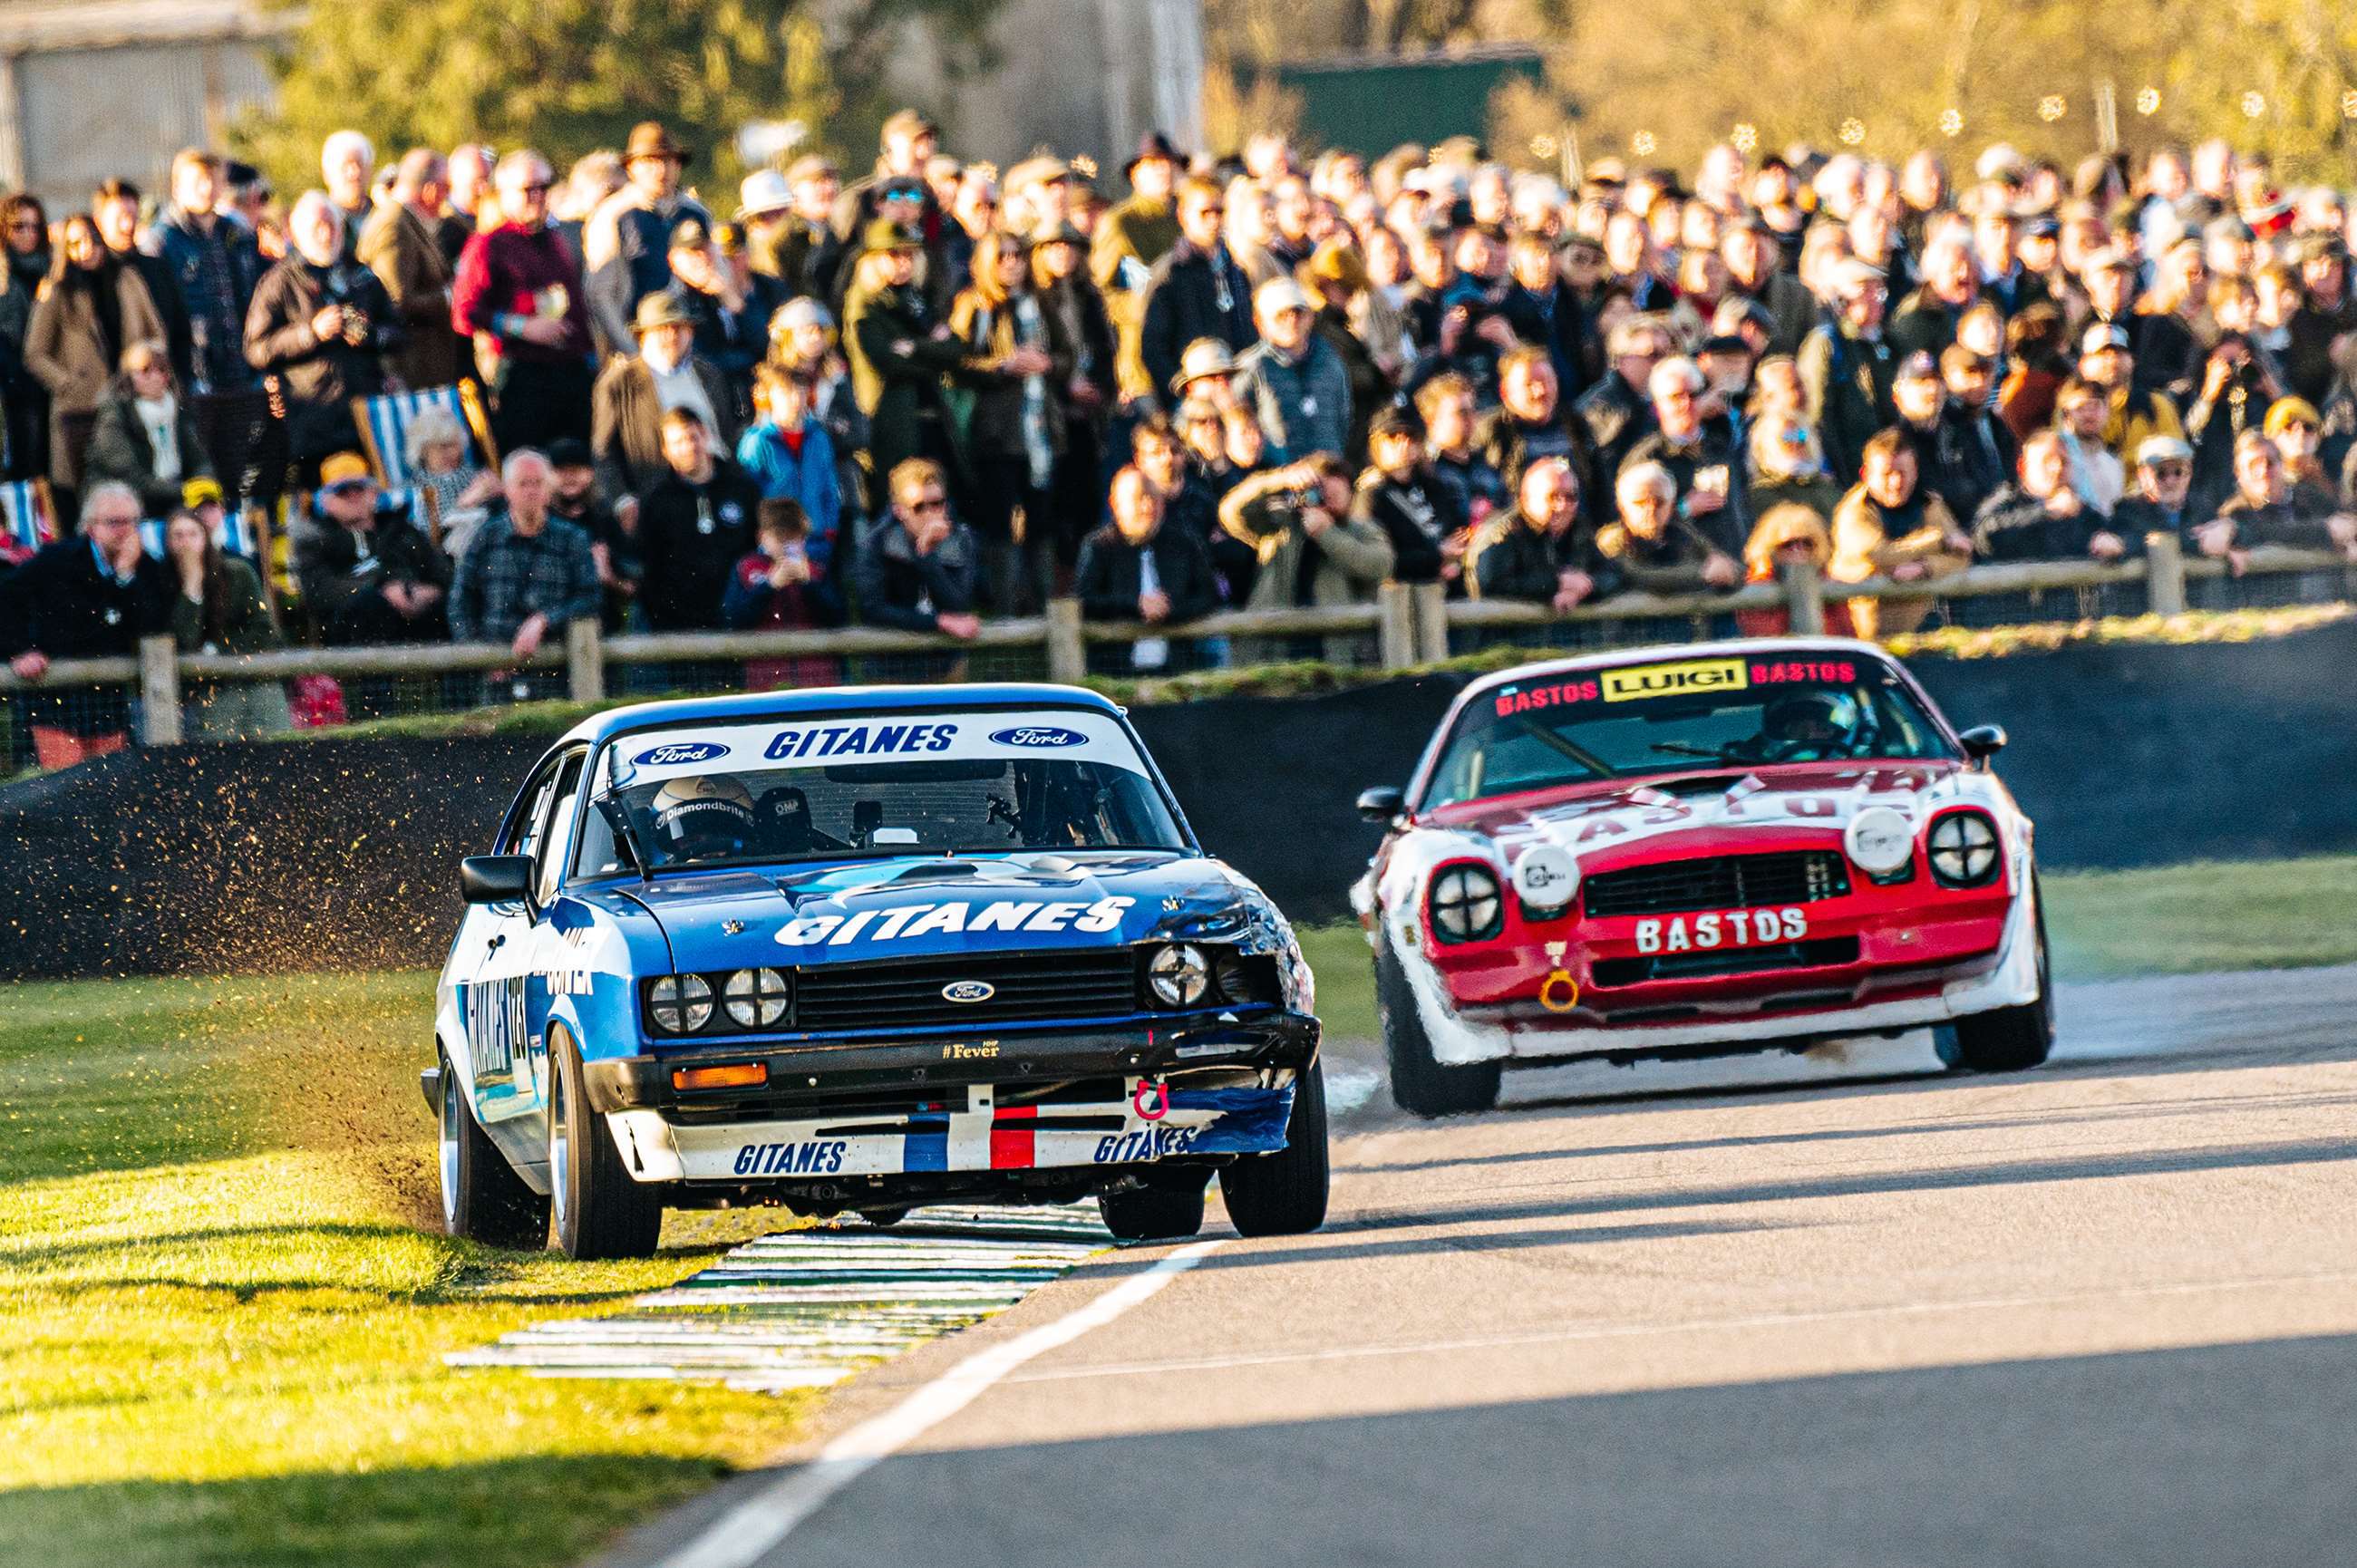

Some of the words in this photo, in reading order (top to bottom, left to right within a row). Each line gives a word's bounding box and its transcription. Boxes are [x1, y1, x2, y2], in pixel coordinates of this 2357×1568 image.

[1612, 669, 1735, 692] LUIGI
[1750, 663, 1856, 684] BASTOS
[1495, 682, 1597, 717] BASTOS
[763, 724, 958, 760] GITANES
[1011, 728, 1070, 748] Ford
[649, 743, 709, 765] Ford
[667, 800, 744, 821] Diamondbrite
[775, 799, 799, 815] OMP
[774, 896, 1136, 946] GITANES
[1636, 907, 1807, 953] BASTOS
[954, 985, 981, 998] Ford
[509, 975, 527, 1060] 123
[943, 1043, 999, 1059] #Fever
[733, 1141, 846, 1175] GITANES
